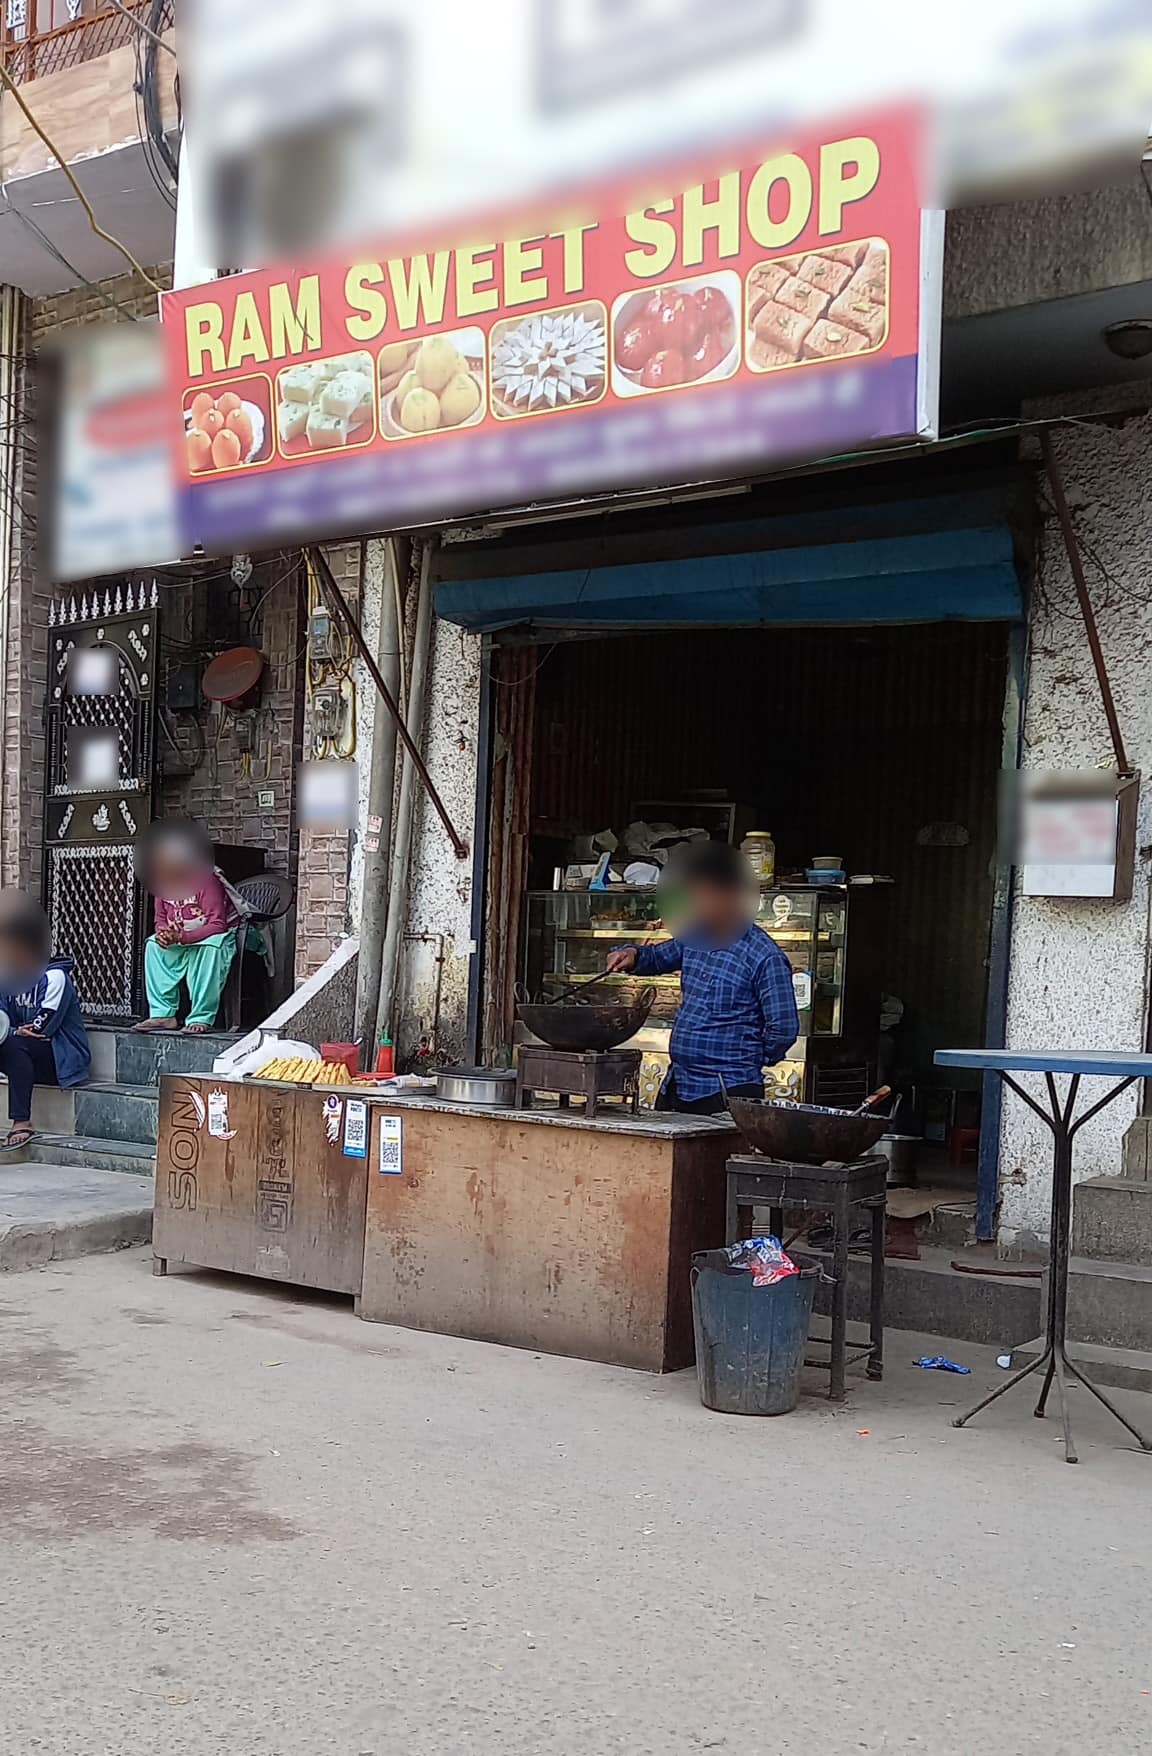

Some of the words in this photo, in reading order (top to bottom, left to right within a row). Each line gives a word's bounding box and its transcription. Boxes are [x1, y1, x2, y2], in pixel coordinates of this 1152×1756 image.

[184, 275, 322, 378] RAM
[343, 221, 599, 342] SWEET
[624, 136, 881, 279] SHOP
[167, 1078, 203, 1211] SON
